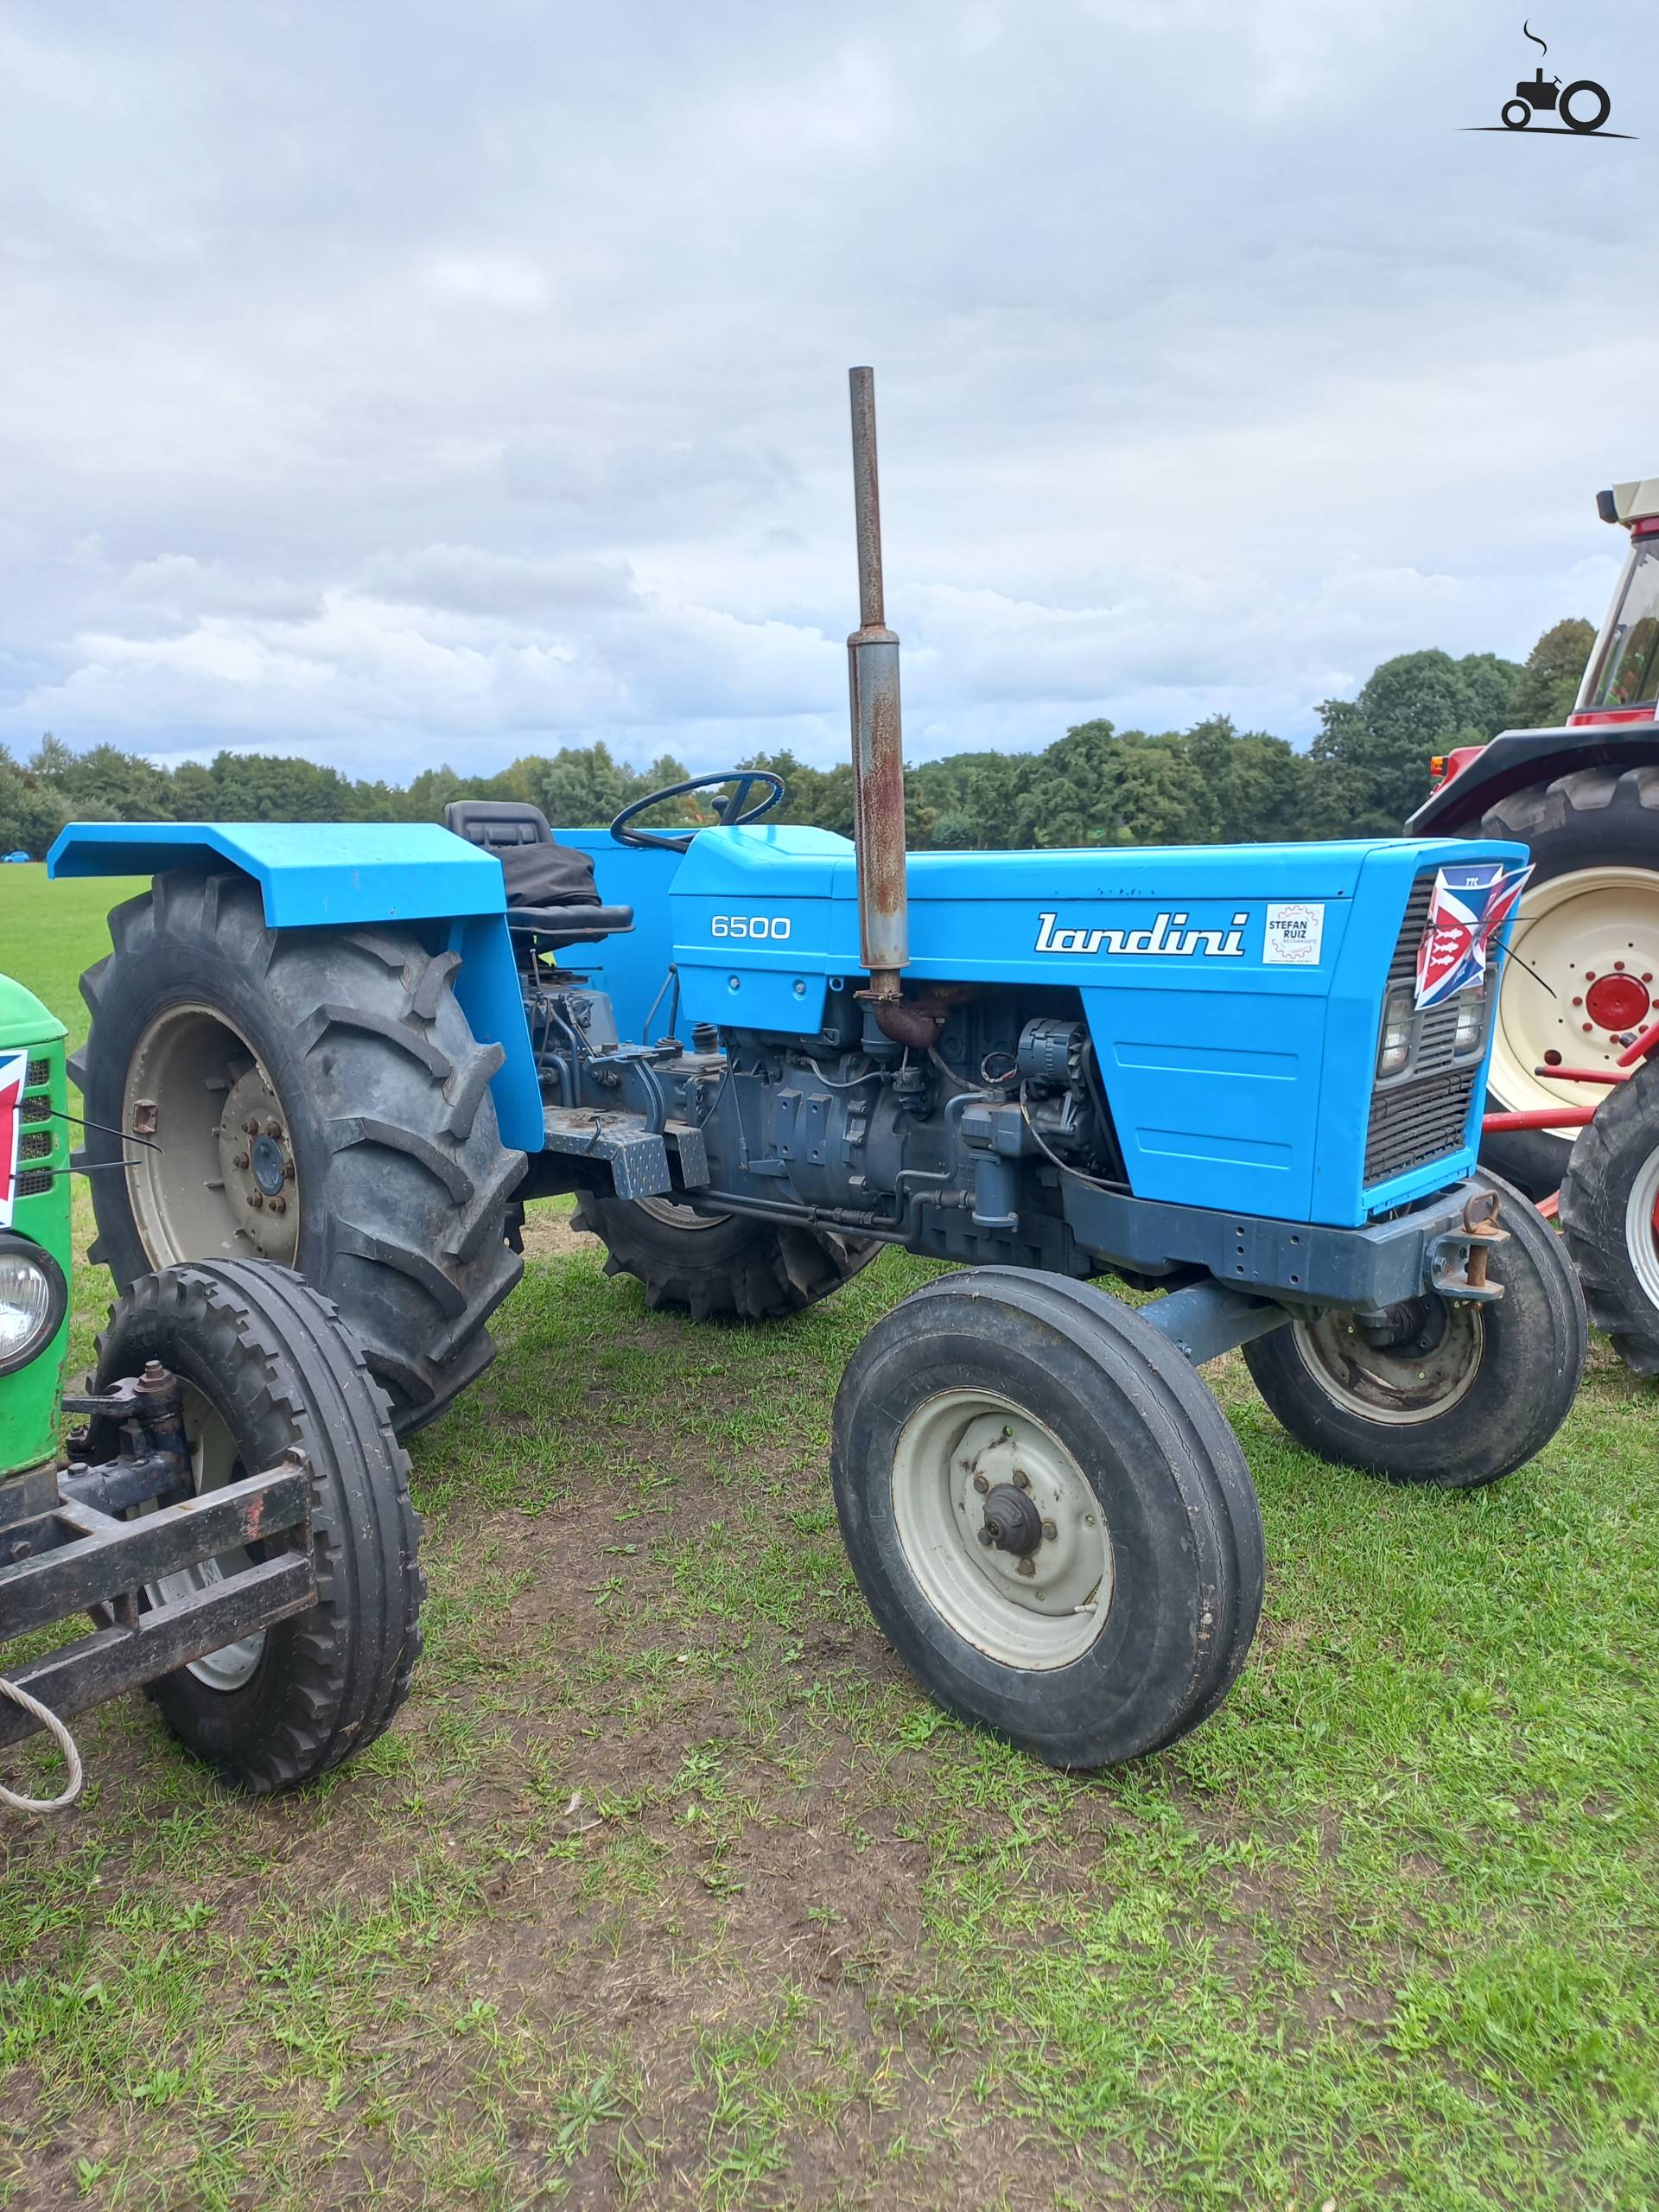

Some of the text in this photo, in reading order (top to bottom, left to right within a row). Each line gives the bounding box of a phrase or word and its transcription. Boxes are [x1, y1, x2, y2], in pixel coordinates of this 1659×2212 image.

[711, 915, 791, 939] 6500
[1269, 920, 1307, 930] STEFAN
[1034, 912, 1249, 956] landini
[1283, 930, 1306, 938] RUIZ
